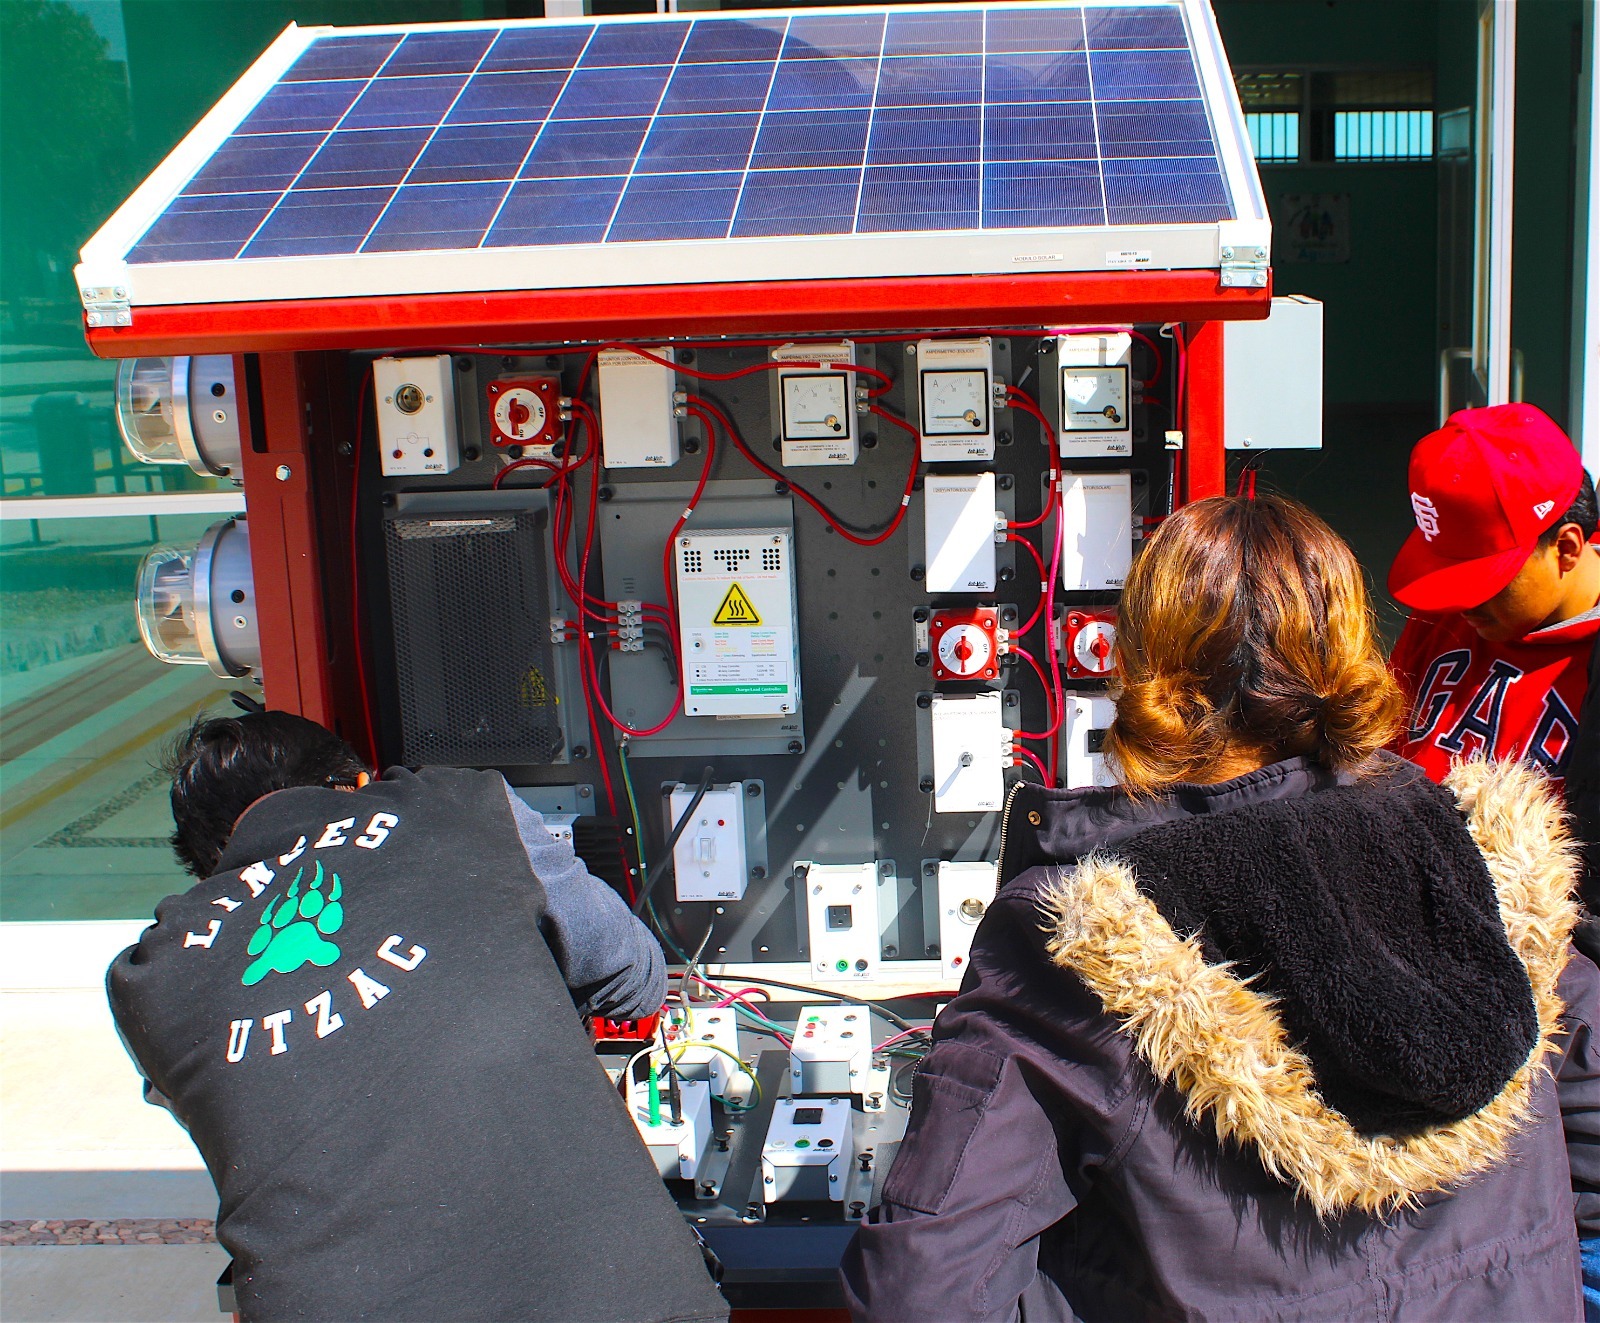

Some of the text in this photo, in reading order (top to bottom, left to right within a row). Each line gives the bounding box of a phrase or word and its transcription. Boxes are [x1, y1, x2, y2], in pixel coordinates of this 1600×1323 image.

[933, 379, 939, 388] A
[794, 384, 799, 393] A
[519, 429, 524, 438] ON
[226, 934, 428, 1063] UTZAC
